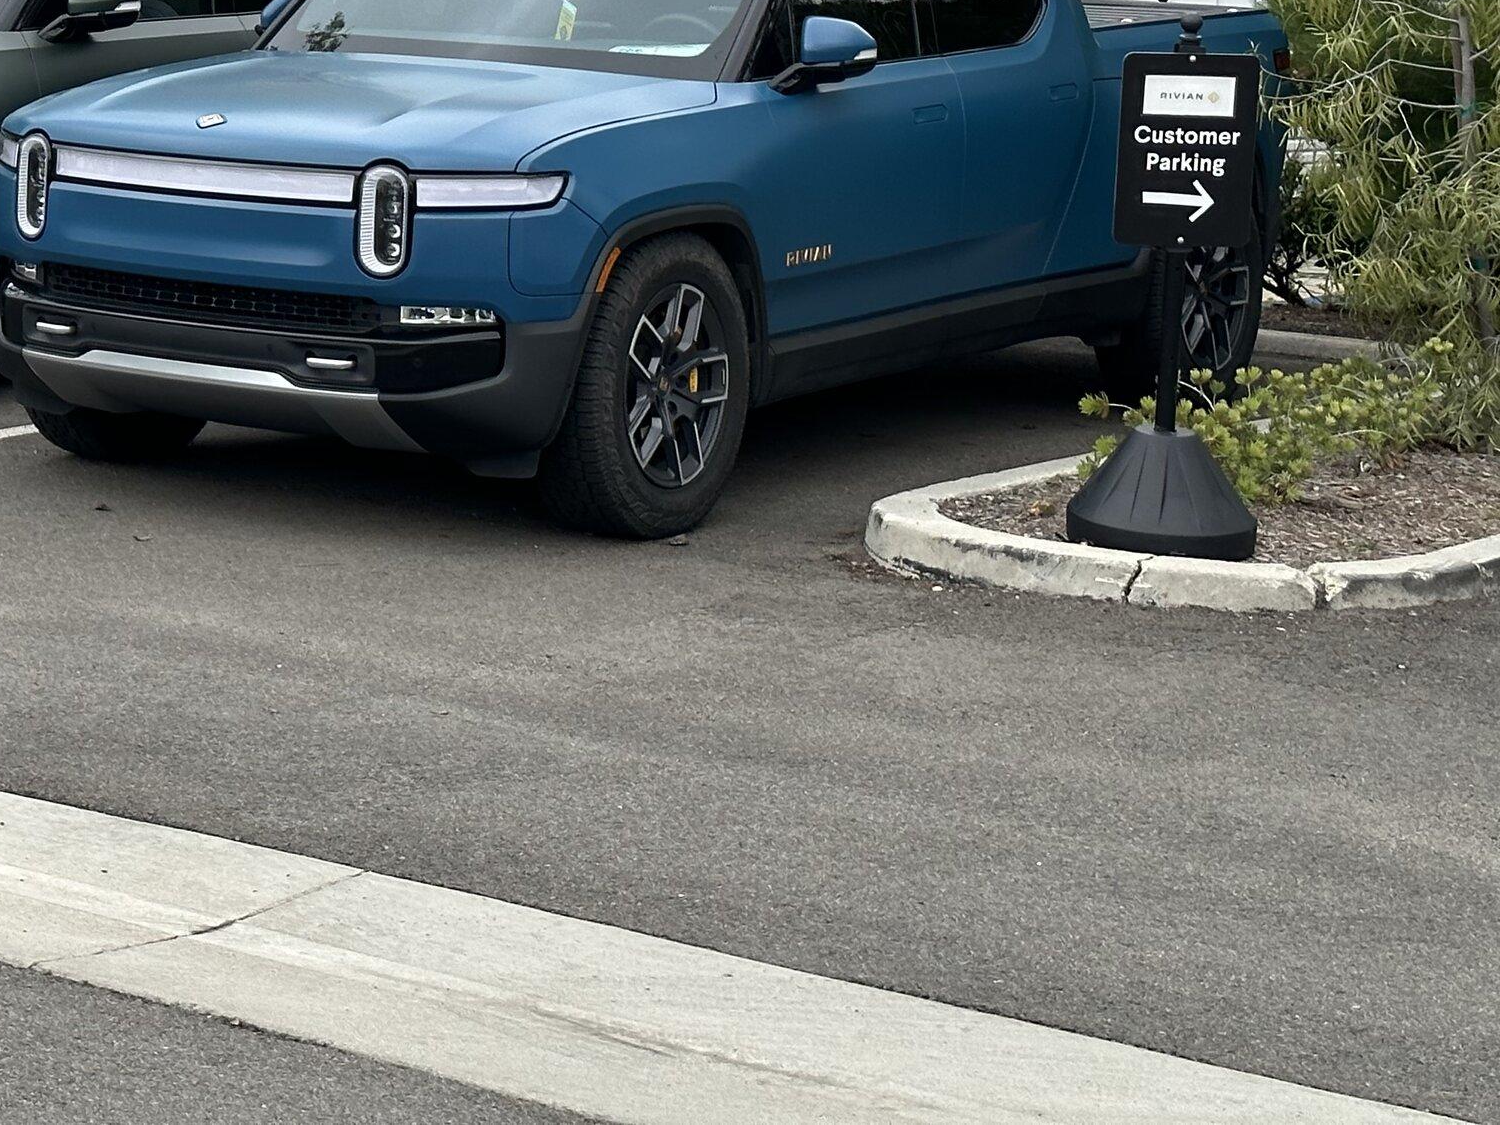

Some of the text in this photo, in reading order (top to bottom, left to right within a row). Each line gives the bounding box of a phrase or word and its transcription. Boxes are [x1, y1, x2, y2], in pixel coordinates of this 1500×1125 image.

[1160, 92, 1204, 101] RIVIAN
[1134, 125, 1241, 145] Customer
[1146, 153, 1226, 177] Parking
